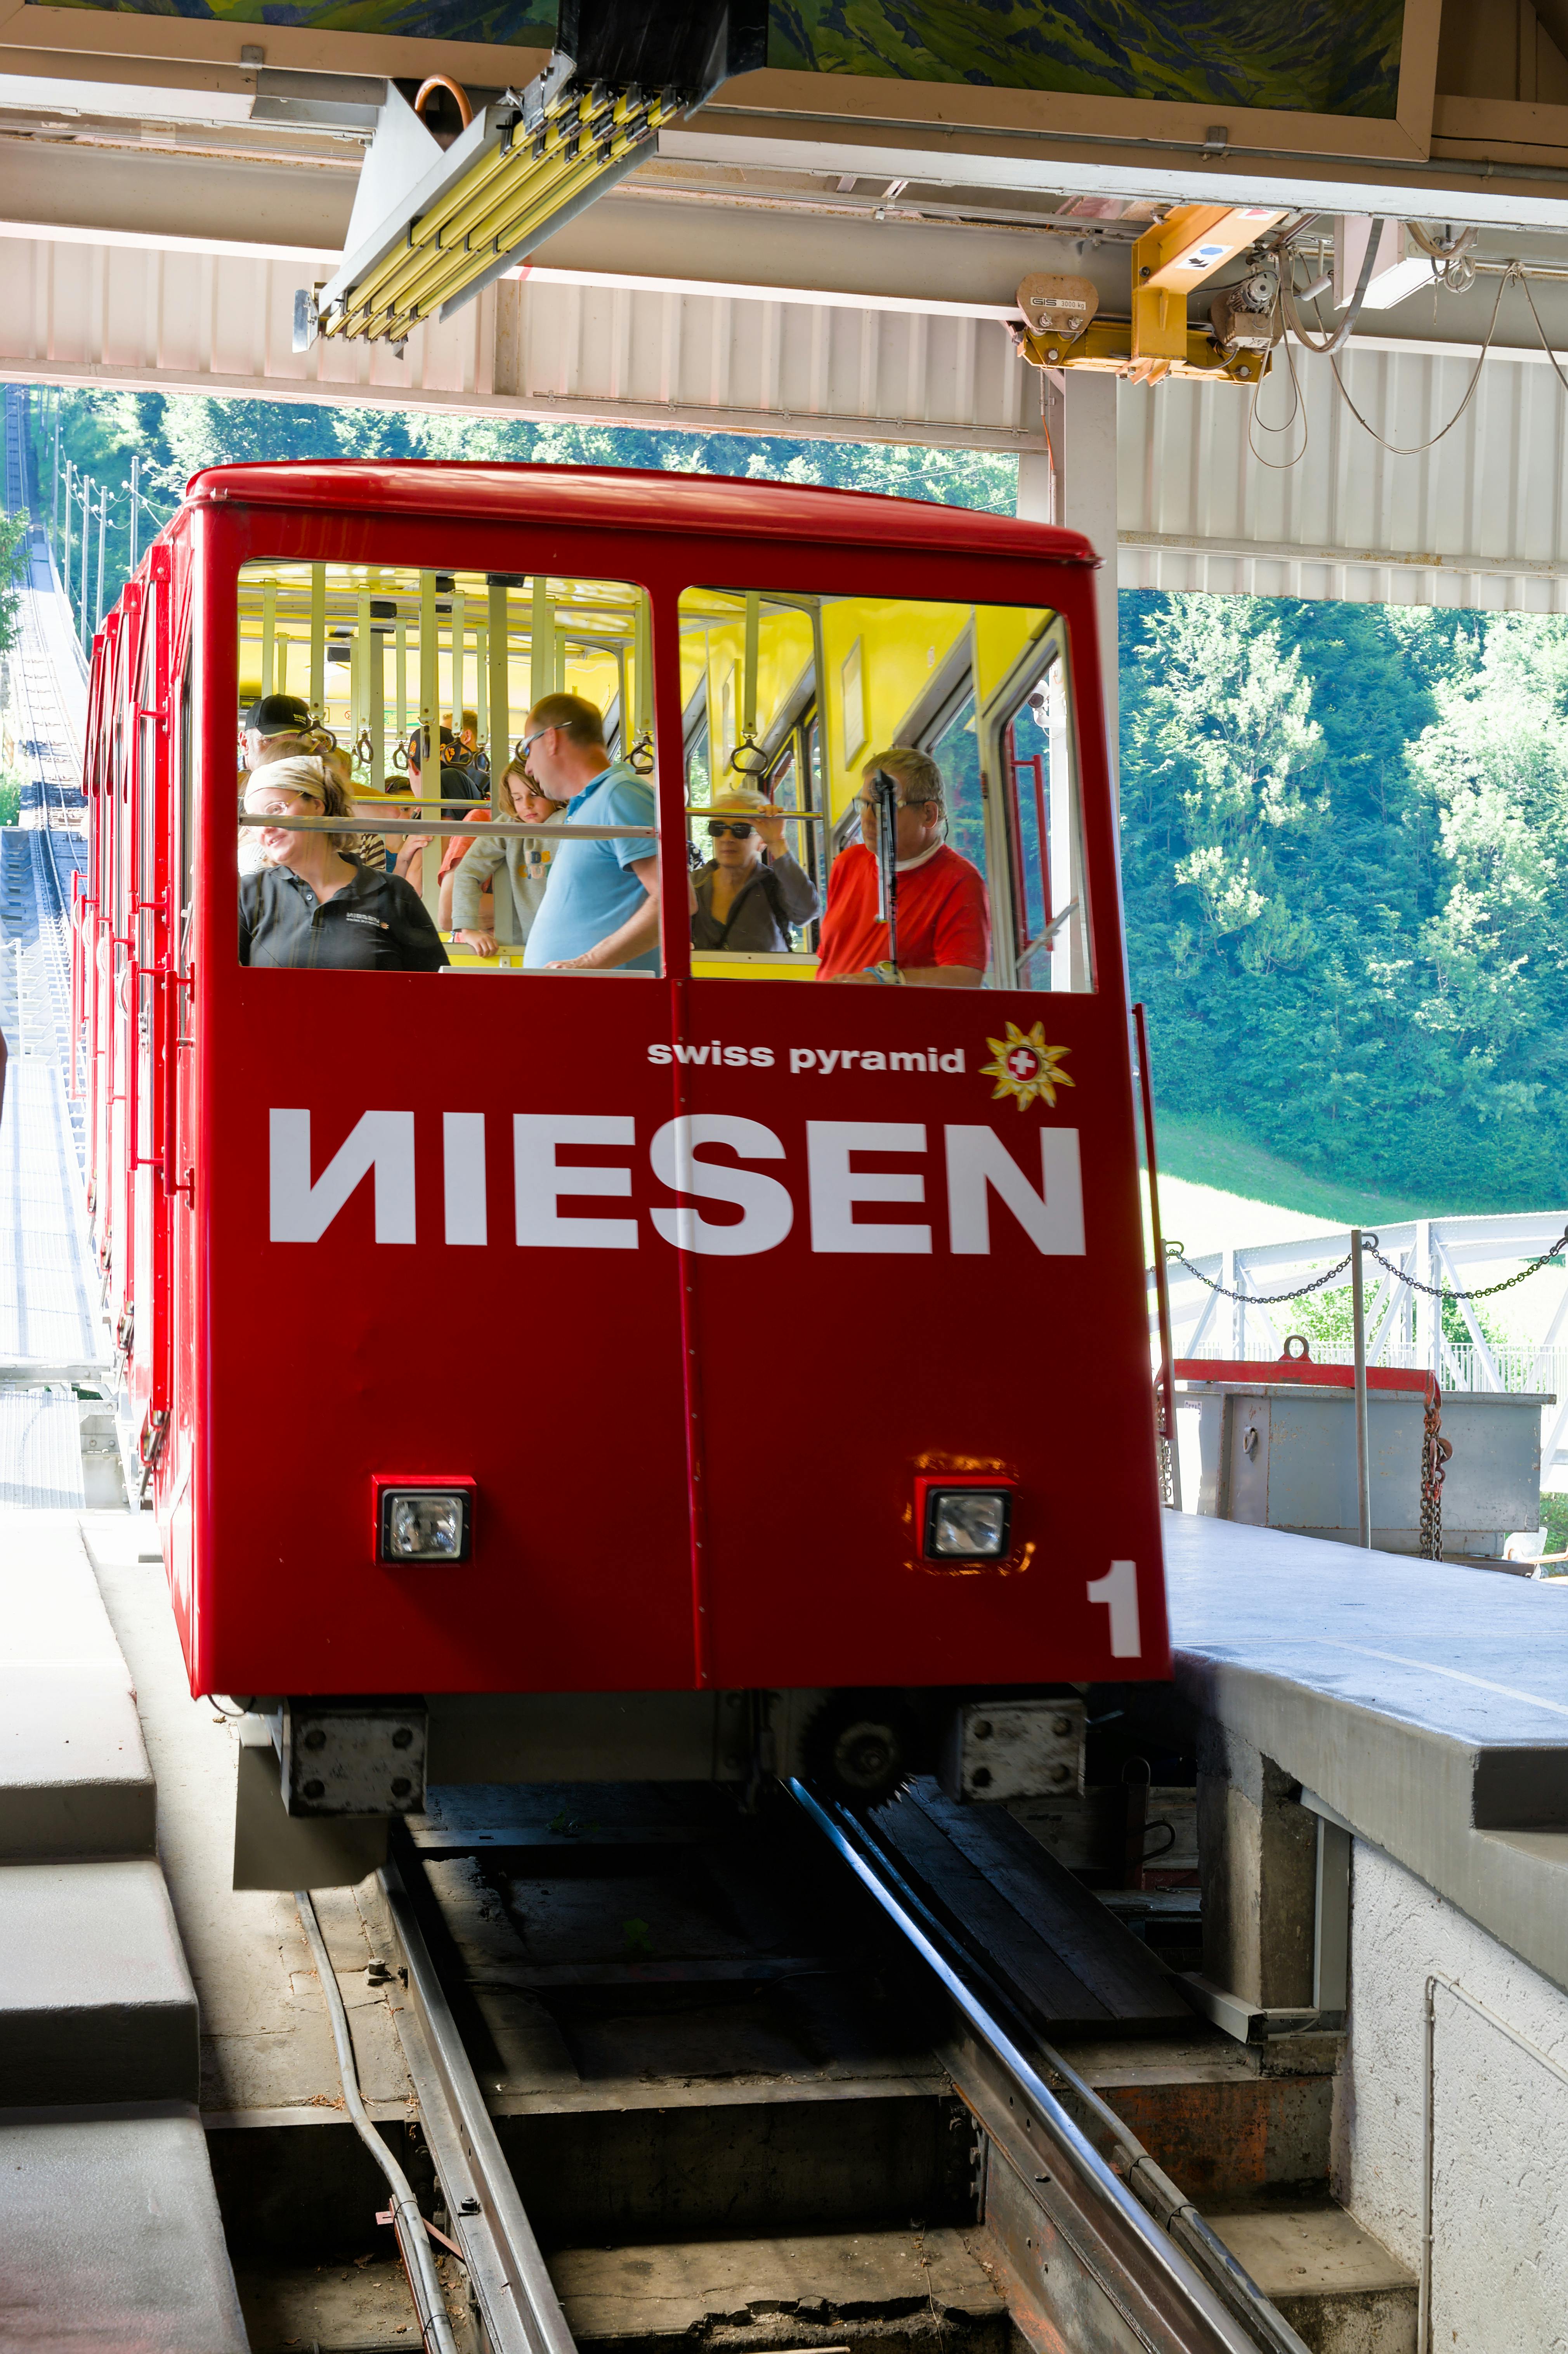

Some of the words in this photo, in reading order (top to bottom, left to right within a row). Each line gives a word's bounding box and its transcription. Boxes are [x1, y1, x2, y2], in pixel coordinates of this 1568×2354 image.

[647, 1040, 775, 1067] swiss
[789, 1047, 966, 1075] pyramid
[1086, 1559, 1142, 1658] 1
